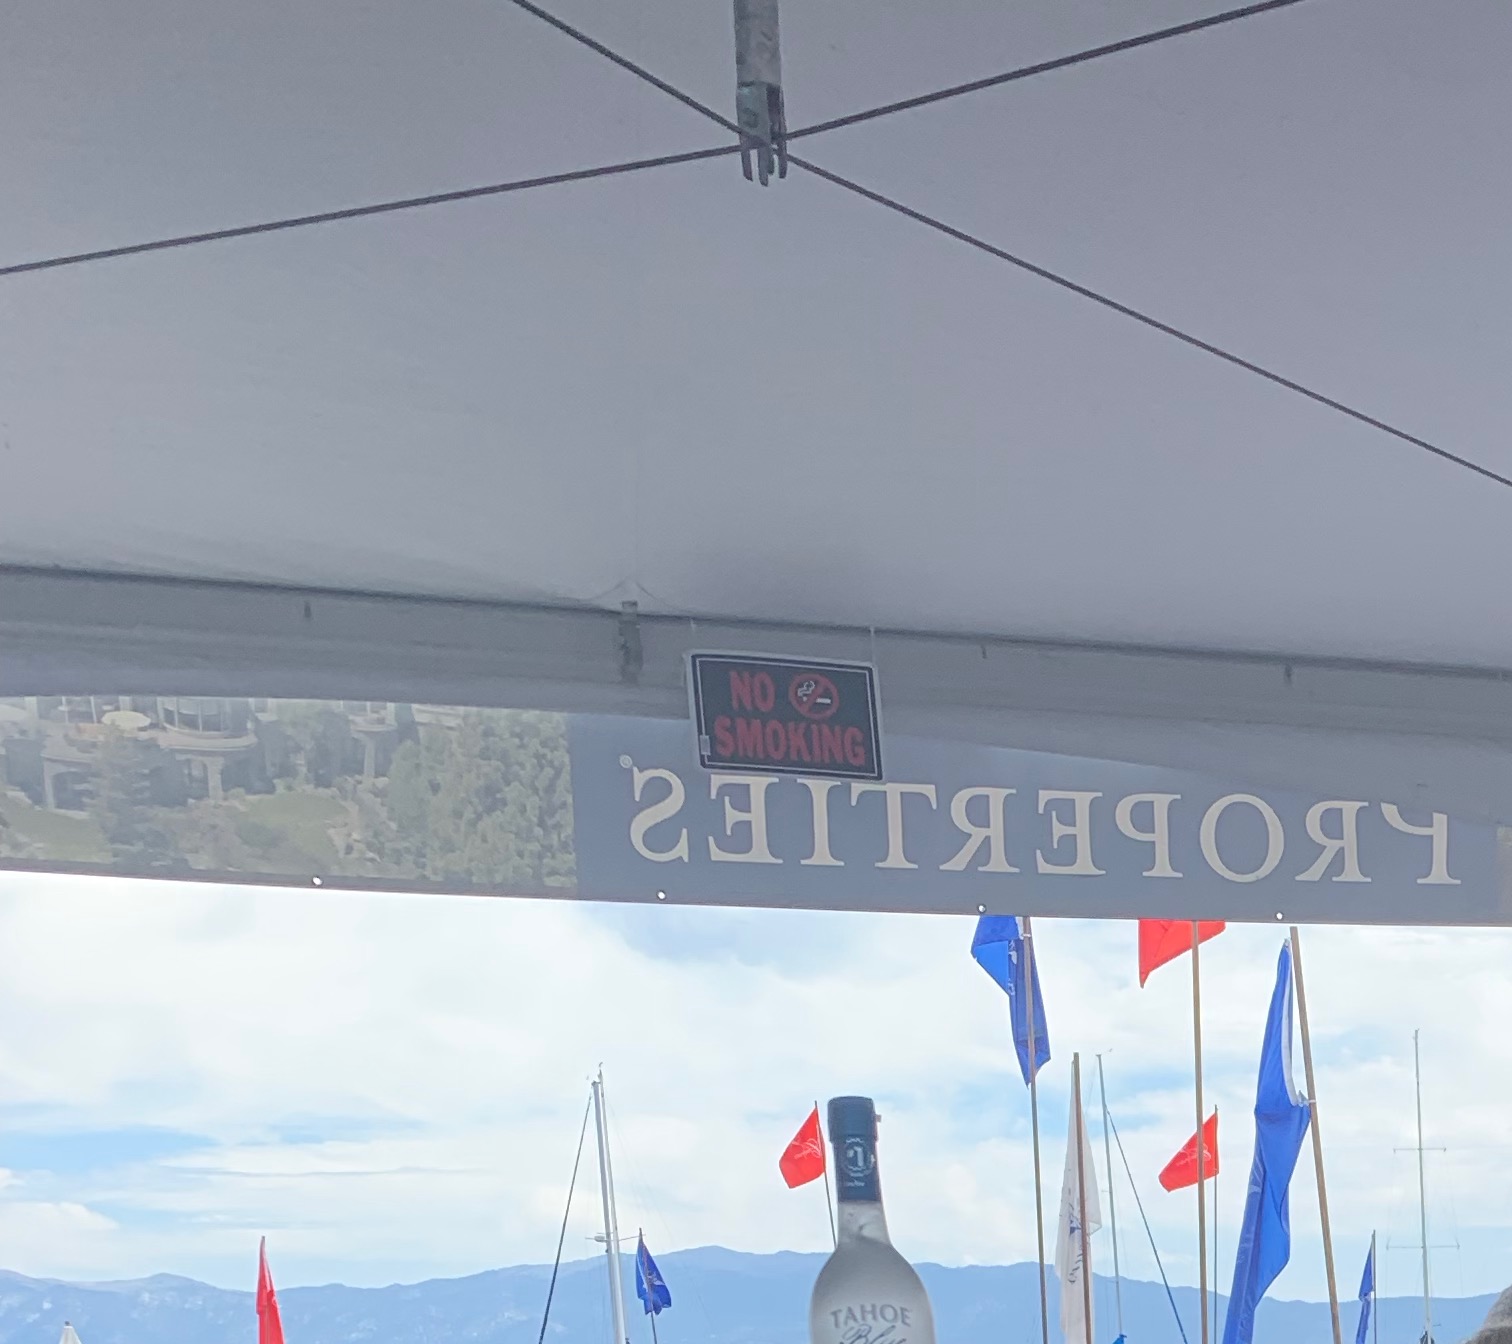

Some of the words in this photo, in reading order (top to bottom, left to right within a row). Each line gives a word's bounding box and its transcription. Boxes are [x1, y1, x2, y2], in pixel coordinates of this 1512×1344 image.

[729, 669, 775, 712] NO
[714, 715, 865, 766] SMOKING
[830, 1303, 913, 1328] TAHOE
